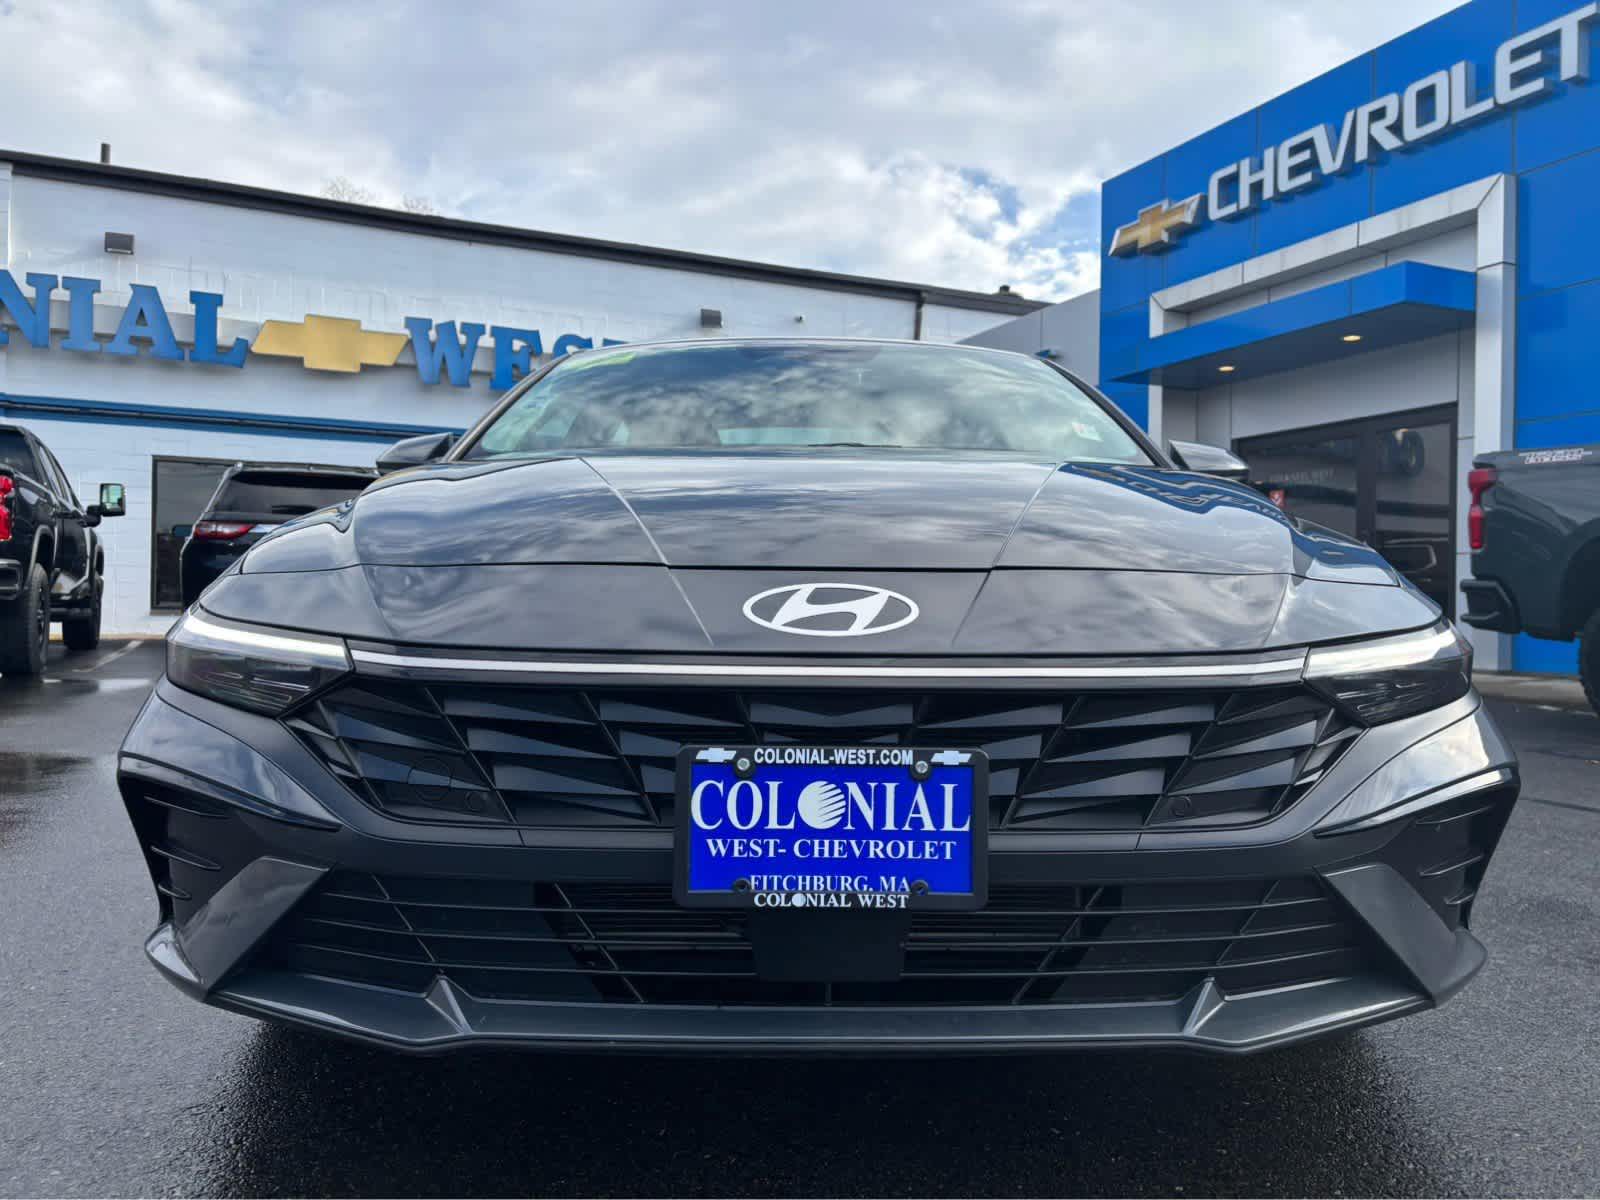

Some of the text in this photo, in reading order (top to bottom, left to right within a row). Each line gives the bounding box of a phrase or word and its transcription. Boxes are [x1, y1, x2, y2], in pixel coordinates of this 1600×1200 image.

[1208, 2, 1599, 222] CHEVROLET
[753, 747, 914, 766] COLONIAL-WEST.COM
[690, 779, 971, 832] COLONIAL
[793, 838, 957, 860] CHEVROLET
[879, 876, 911, 893] MA
[753, 893, 909, 909] COLONIAL WEST
